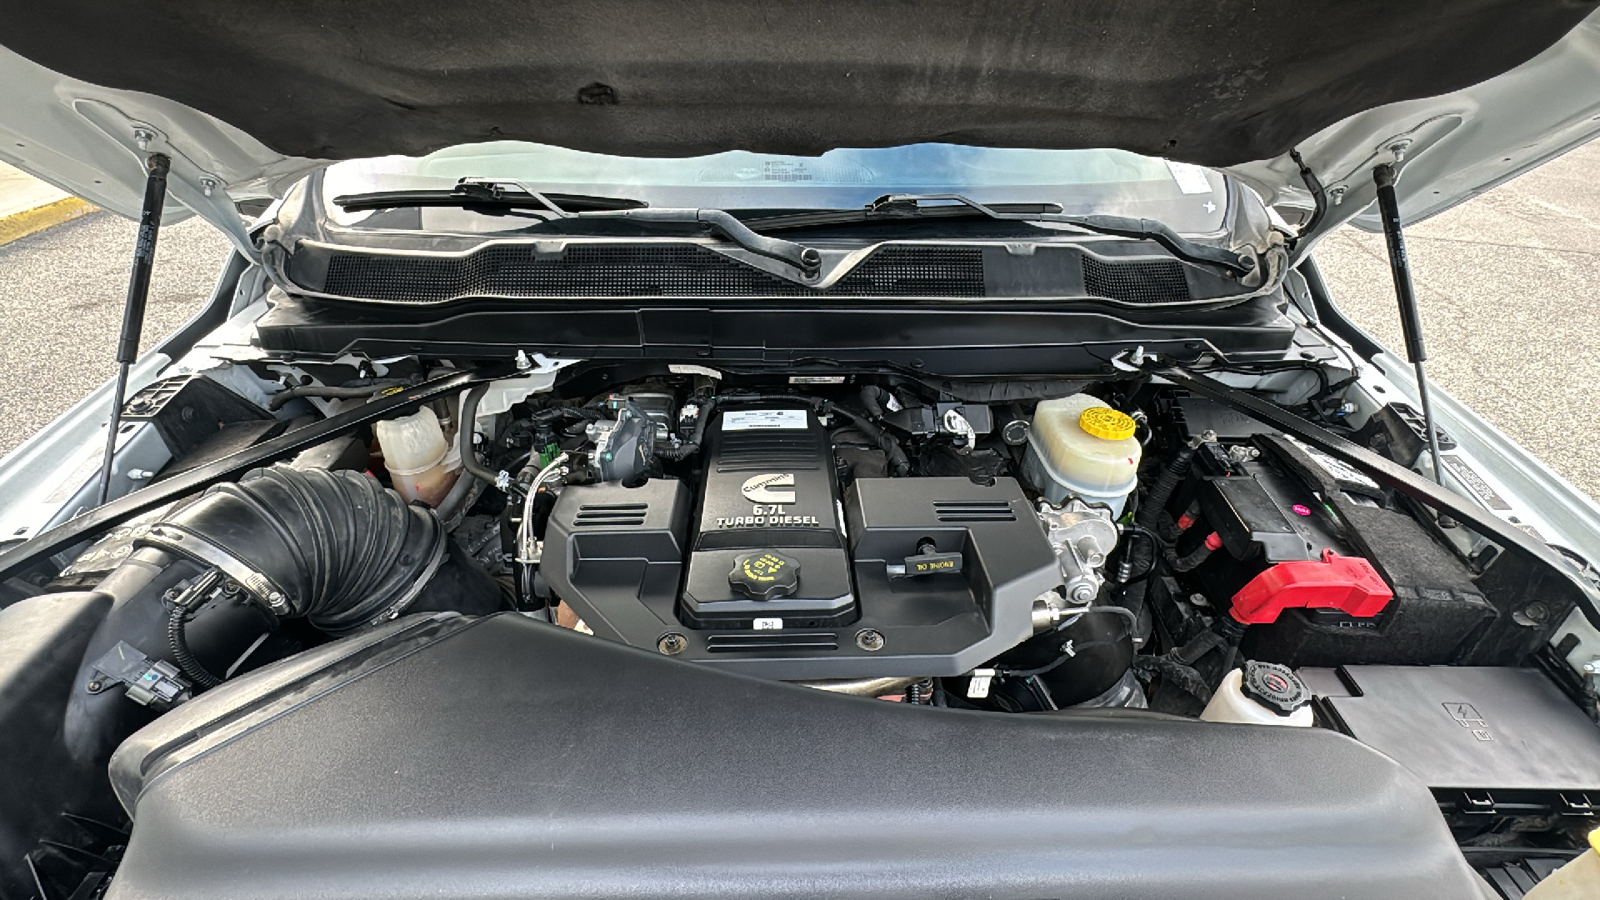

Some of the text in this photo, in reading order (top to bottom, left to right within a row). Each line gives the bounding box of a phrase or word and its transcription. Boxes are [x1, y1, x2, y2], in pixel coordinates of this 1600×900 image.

[743, 473, 790, 493] Cummins
[752, 504, 786, 515] 6.7L
[716, 516, 819, 527] TURBO DIESEL
[916, 561, 954, 571] ENGINE OIL
